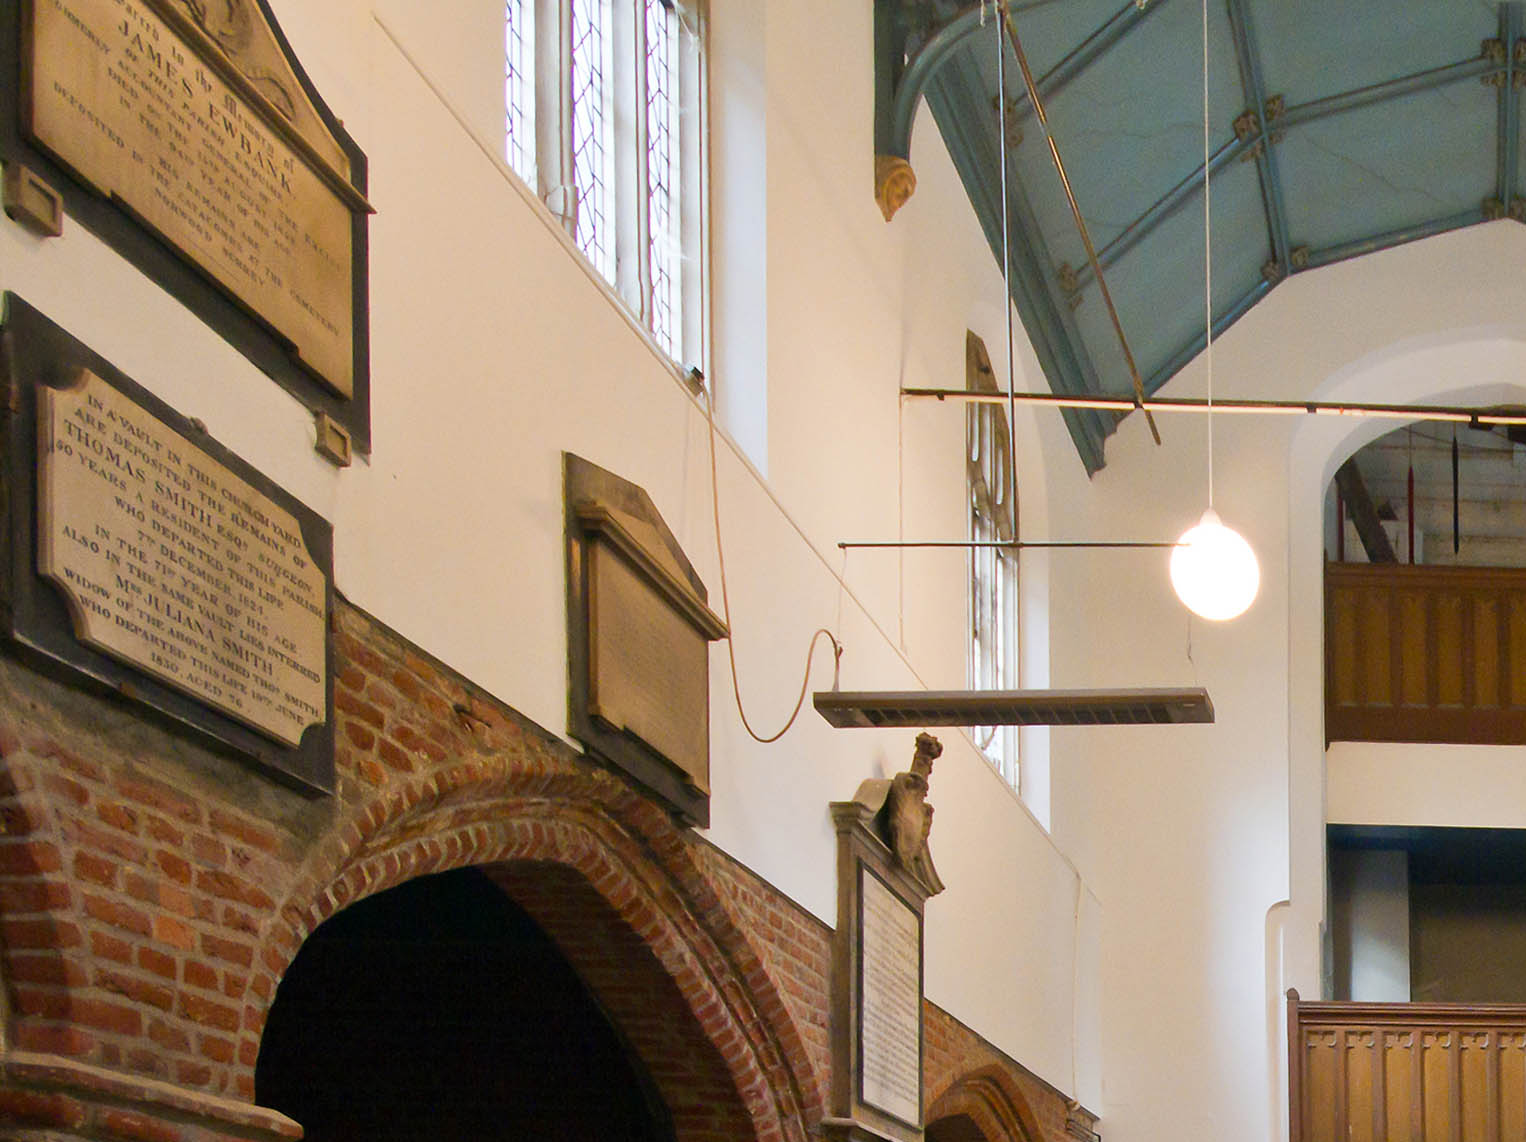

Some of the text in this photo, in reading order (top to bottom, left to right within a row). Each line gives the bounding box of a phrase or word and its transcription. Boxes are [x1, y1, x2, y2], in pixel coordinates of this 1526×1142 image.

[118, 19, 192, 98] JAMES
[54, 82, 124, 148] DEPOSITED
[155, 189, 211, 240] NORWOOD
[64, 418, 144, 484] THOMAS
[155, 479, 211, 528] SMITH
[74, 405, 307, 571] ARE DEPOSITED THE REMAINS OF
[87, 392, 102, 413] IN
[119, 415, 160, 453] VAULT
[167, 449, 181, 467] IN
[189, 463, 215, 491] THIS
[78, 452, 126, 492] YEARS
[135, 489, 144, 503] A
[151, 499, 218, 551] RESIDENT
[225, 547, 240, 566] OF
[248, 561, 274, 588] THIS
[114, 494, 144, 522] WHO
[152, 519, 222, 572] DEPARTED
[228, 566, 253, 592] THIS
[62, 523, 319, 683] ALSO IN THE SAME VAULT LIES INTERRED
[64, 566, 109, 599] WIDOW
[115, 595, 129, 611] OF
[137, 607, 164, 631] THE
[169, 626, 206, 654] ABOVE
[212, 650, 249, 678] NAMED
[95, 523, 110, 541] IN
[117, 536, 146, 563] THE
[181, 576, 217, 605] YEAR
[224, 601, 240, 620] OF
[247, 614, 267, 636] HIS
[144, 590, 214, 641] JULIANA
[80, 594, 110, 620] WHO
[115, 614, 185, 660] DEPARTED
[191, 655, 218, 679] THIS
[223, 673, 247, 695] LIFE
[275, 701, 304, 726] JUNE
[187, 670, 221, 698] AGED
